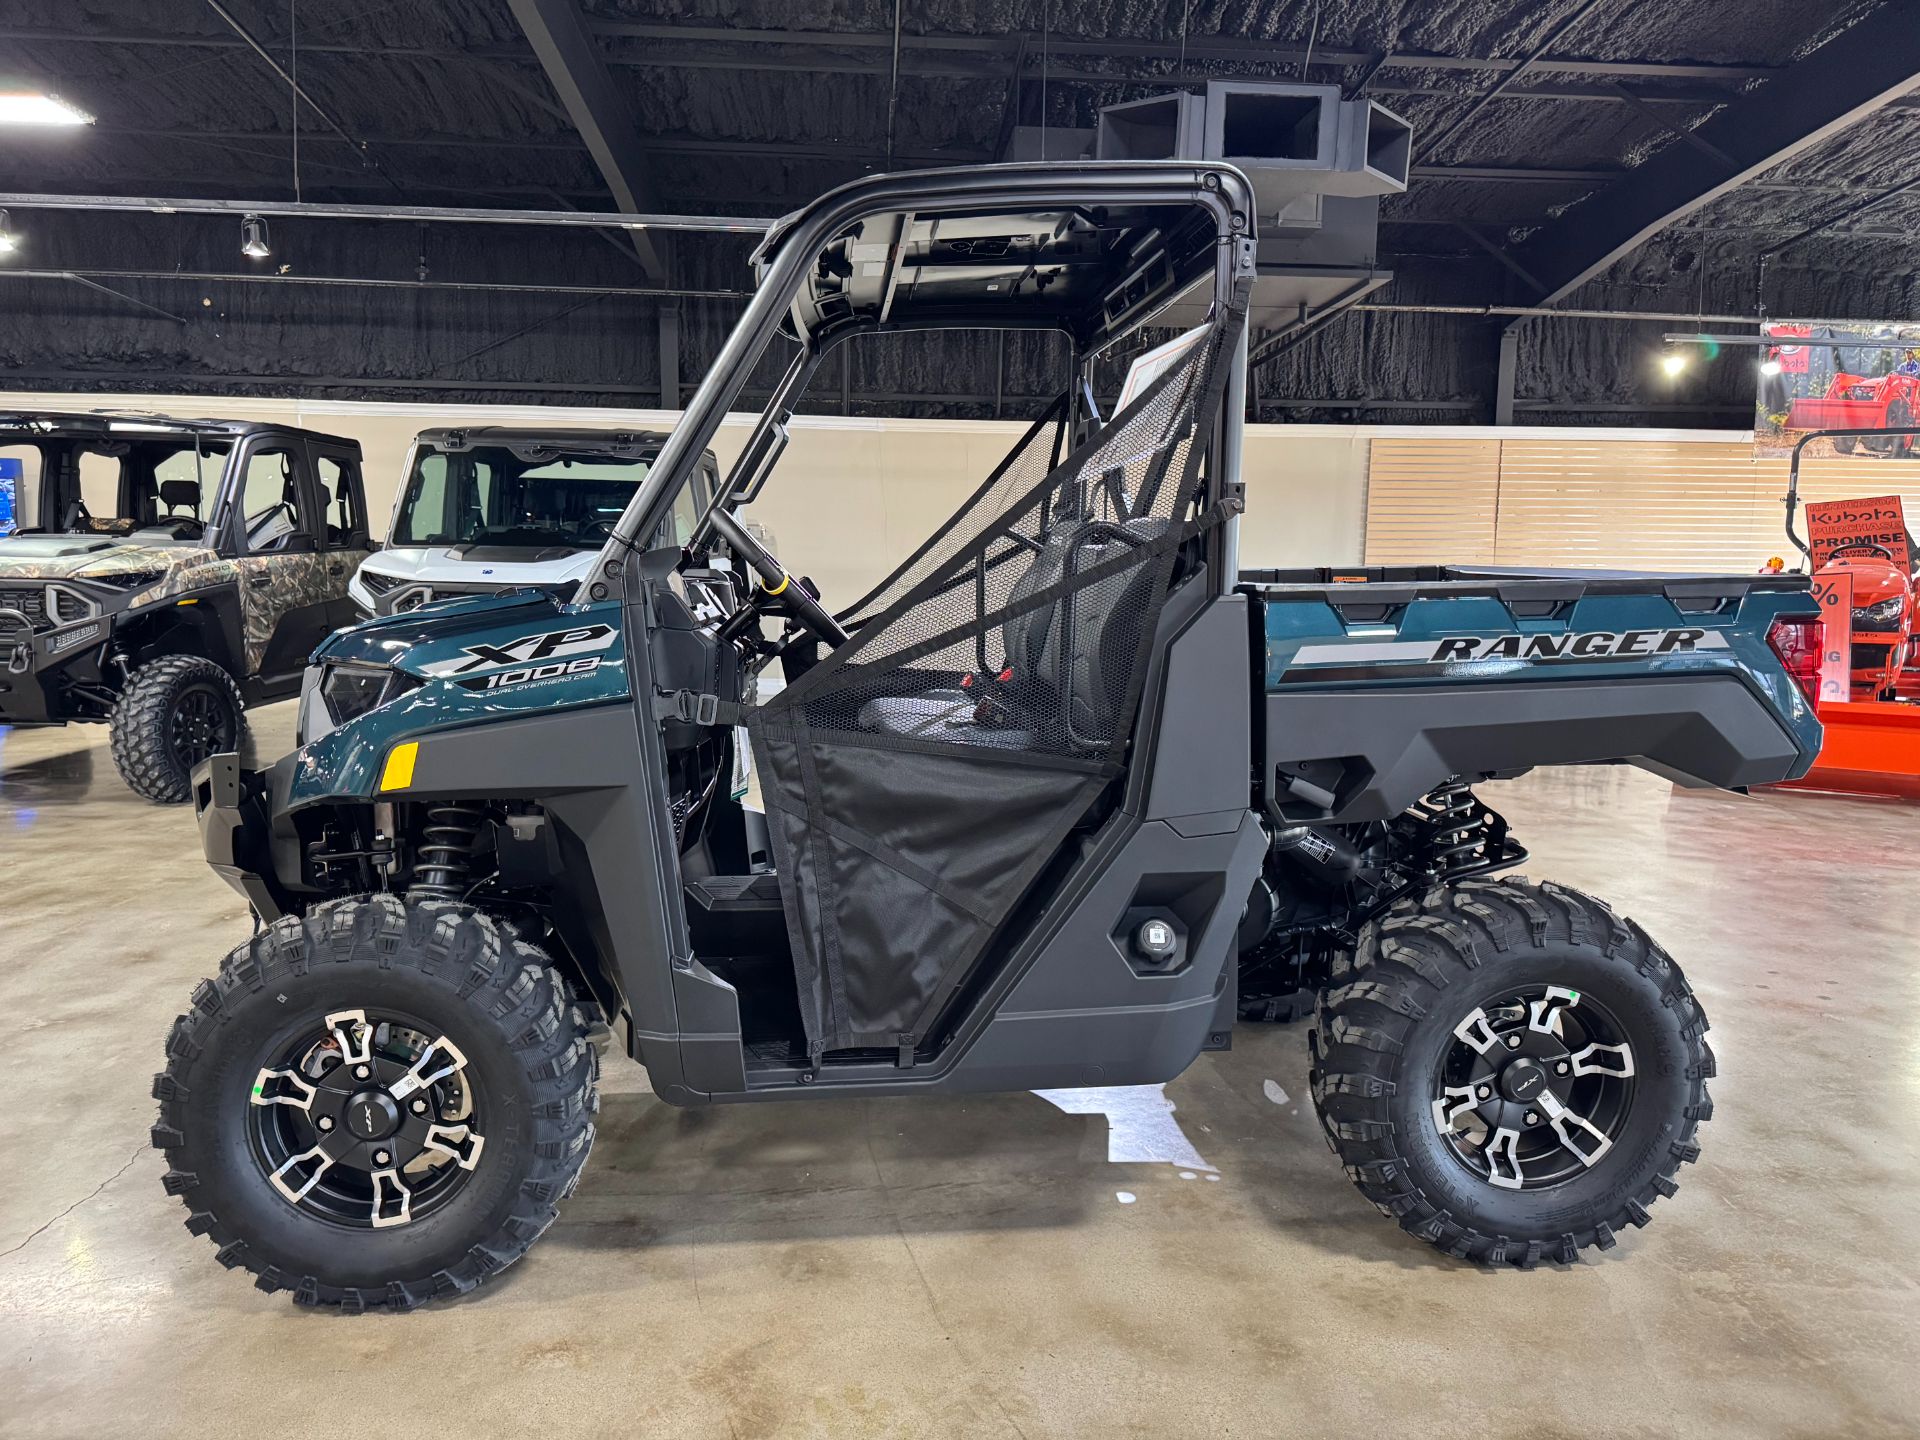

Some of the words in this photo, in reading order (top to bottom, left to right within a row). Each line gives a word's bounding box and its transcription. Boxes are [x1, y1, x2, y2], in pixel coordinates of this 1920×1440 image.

[1811, 508, 1898, 525] Kubota
[1811, 521, 1903, 536] PURCHASE
[1813, 532, 1905, 548] PROMISE
[453, 624, 612, 674] XP
[1428, 628, 1705, 664] RANGER
[486, 687, 514, 697] DUAL
[516, 676, 573, 692] OVERHEAD
